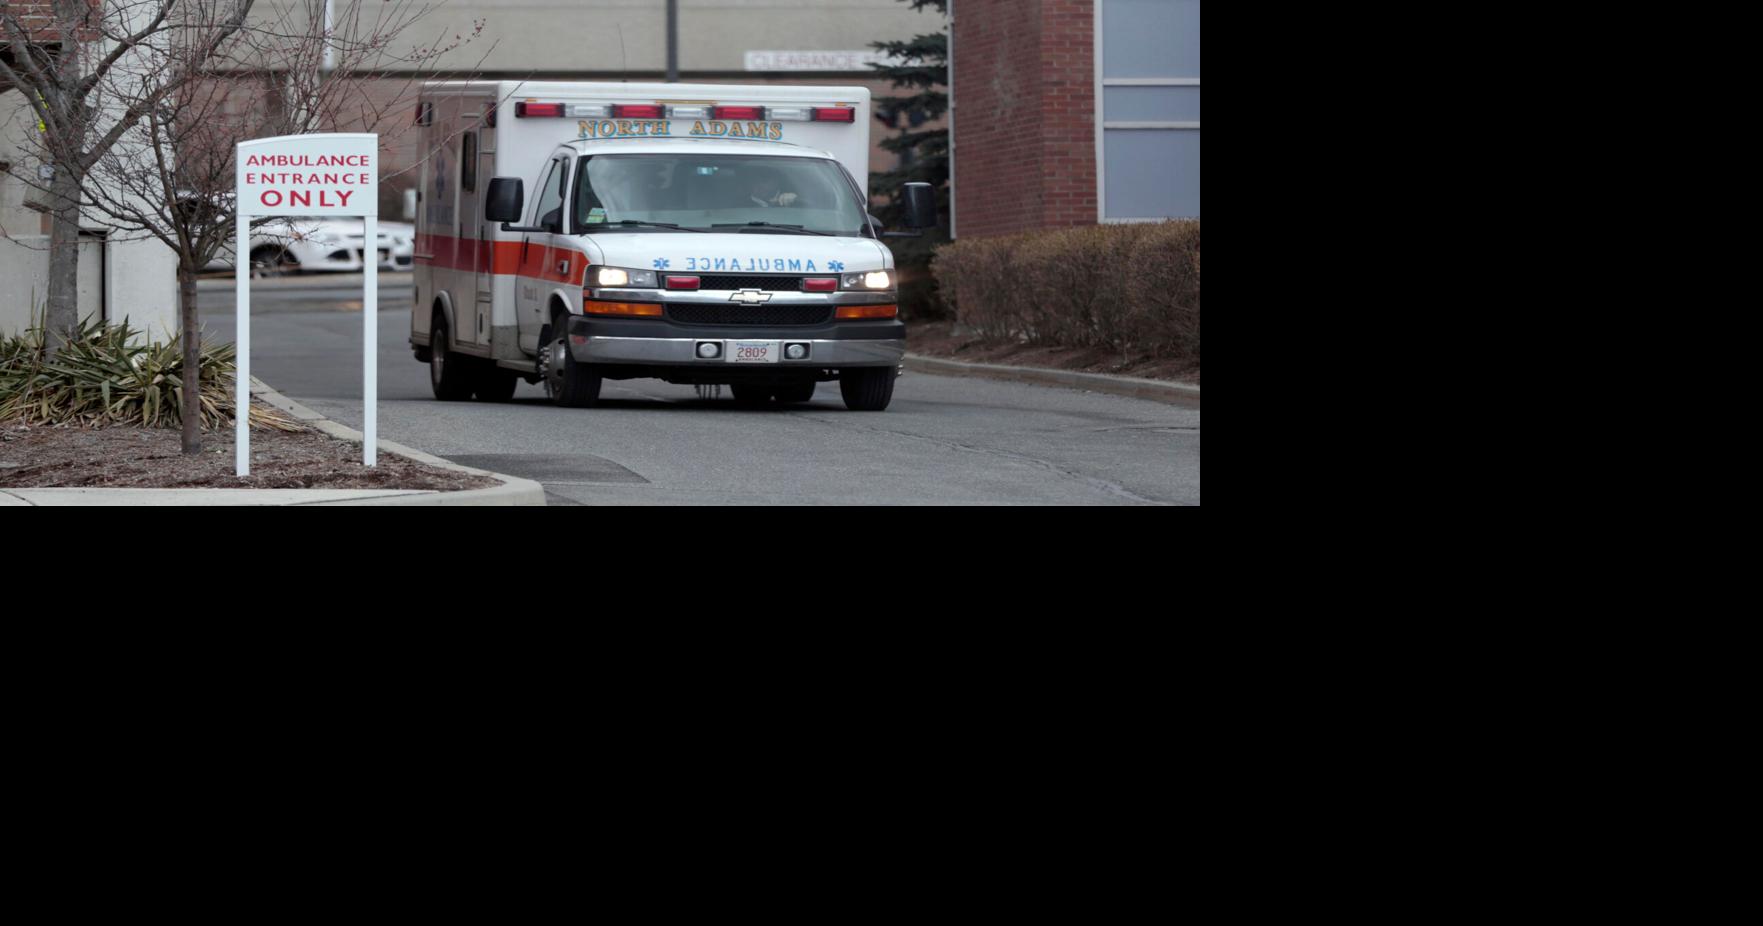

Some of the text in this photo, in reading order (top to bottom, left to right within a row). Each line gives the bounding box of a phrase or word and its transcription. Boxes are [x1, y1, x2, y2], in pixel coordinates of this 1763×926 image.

[577, 120, 783, 140] NORTH ADAMS
[246, 155, 370, 166] AMBULANCE
[246, 173, 370, 184] ENTRANCE
[260, 190, 354, 207] ONLY
[737, 347, 767, 358] 2809
